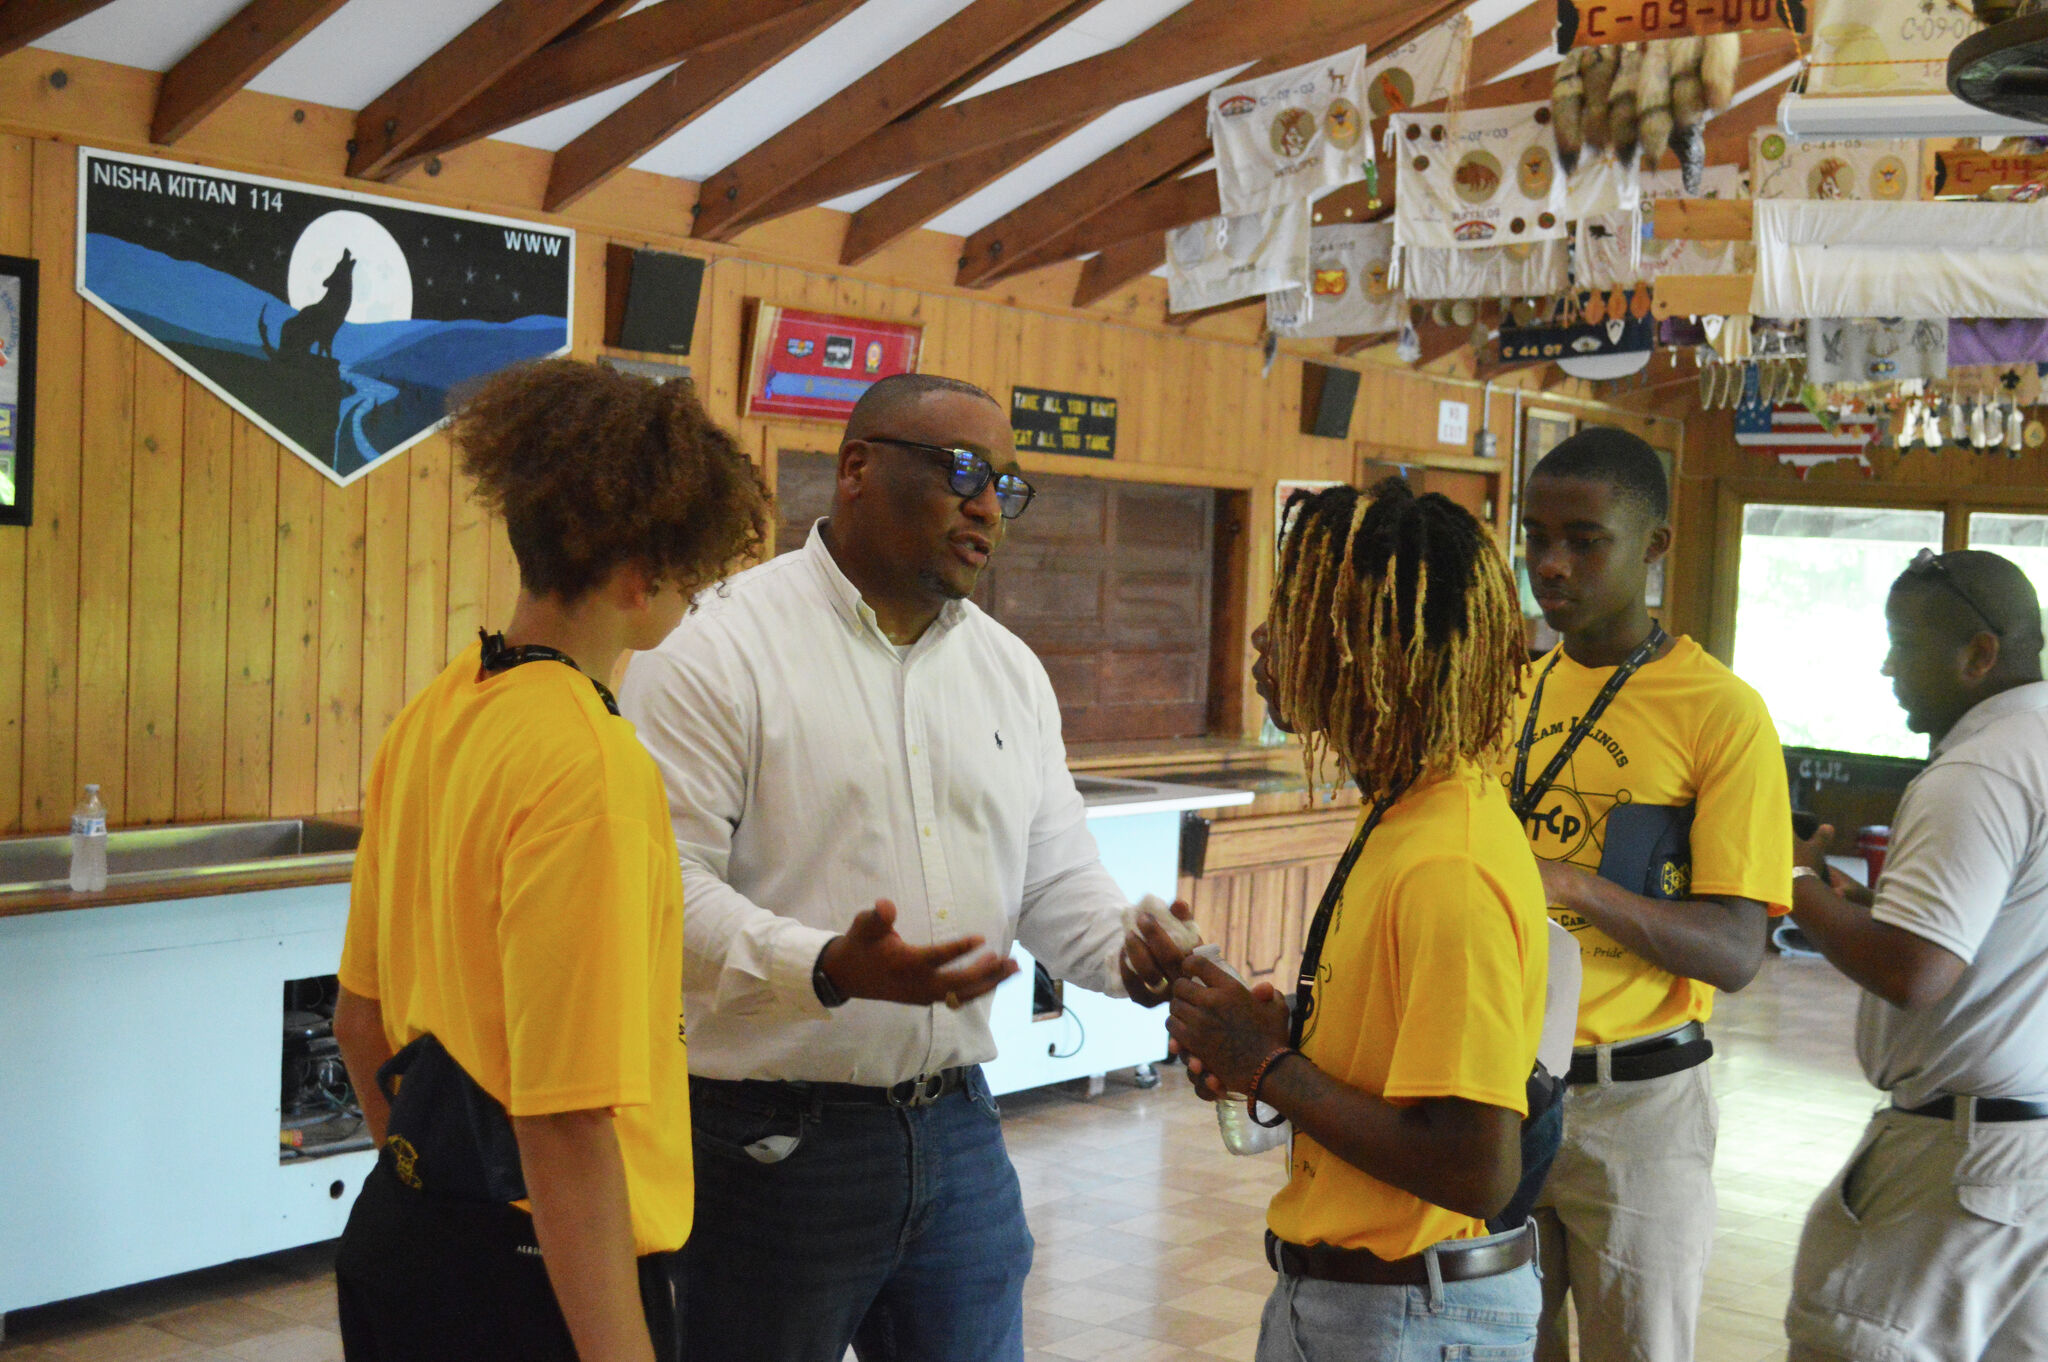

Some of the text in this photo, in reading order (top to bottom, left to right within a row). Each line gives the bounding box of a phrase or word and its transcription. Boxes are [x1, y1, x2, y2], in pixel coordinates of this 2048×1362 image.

[93, 161, 283, 213] NISHA KITTAN 114
[503, 230, 562, 257] WWW
[1014, 391, 1040, 411] TAKE
[1043, 396, 1063, 413] ALL
[1066, 398, 1088, 415] YOU
[1037, 430, 1057, 448] ALL
[1061, 432, 1081, 450] YOU
[1085, 434, 1111, 452] TAKE
[1515, 721, 1564, 748] EAM
[1568, 716, 1629, 768] ILINOIS
[1593, 946, 1622, 959] Pride
